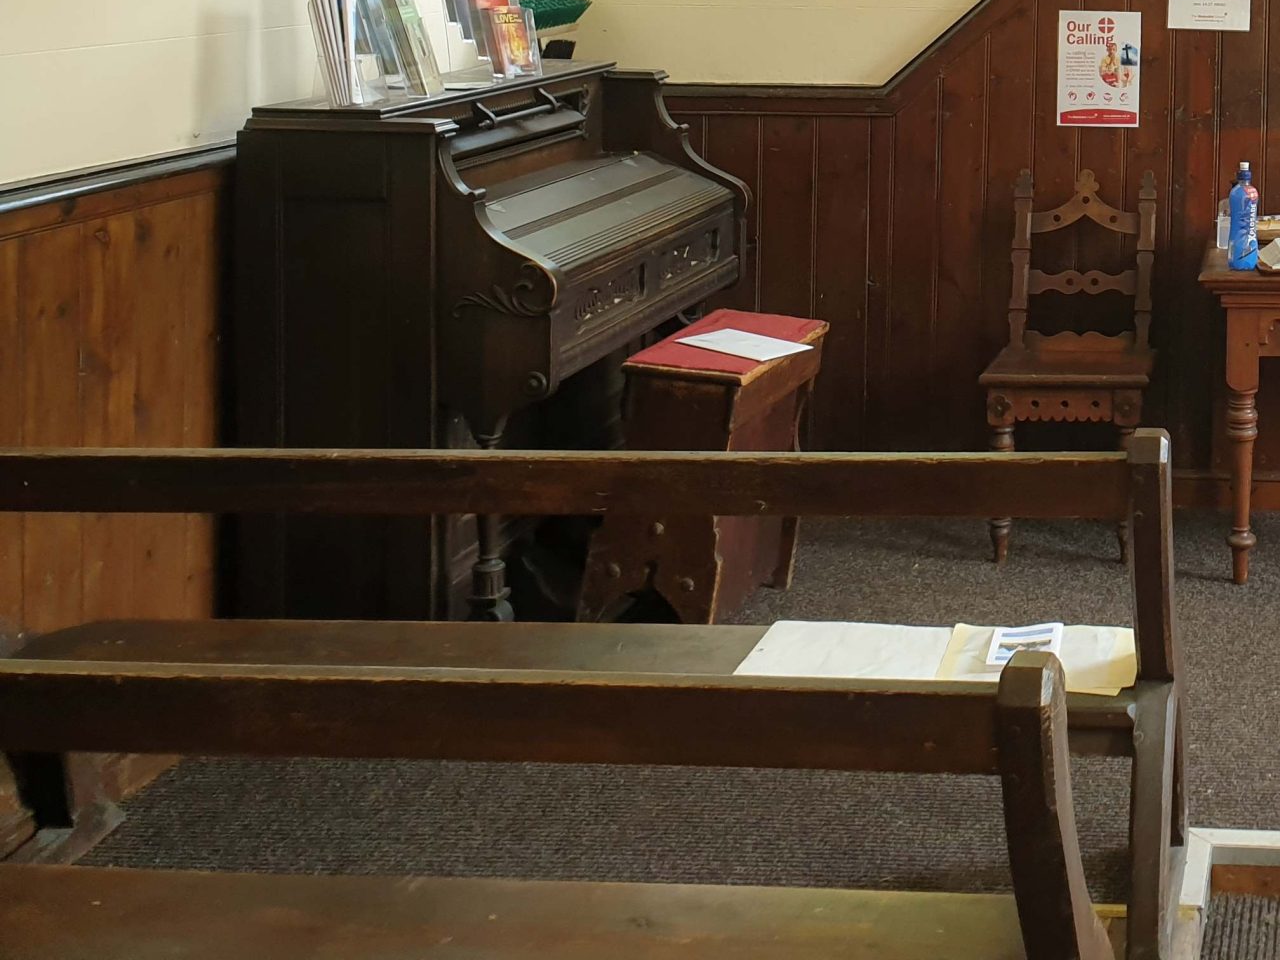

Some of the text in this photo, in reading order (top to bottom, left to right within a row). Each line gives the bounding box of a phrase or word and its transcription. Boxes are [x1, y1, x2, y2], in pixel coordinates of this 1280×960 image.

[494, 12, 515, 24] LOVE
[1066, 20, 1091, 32] Our
[1066, 33, 1114, 47] Calling
